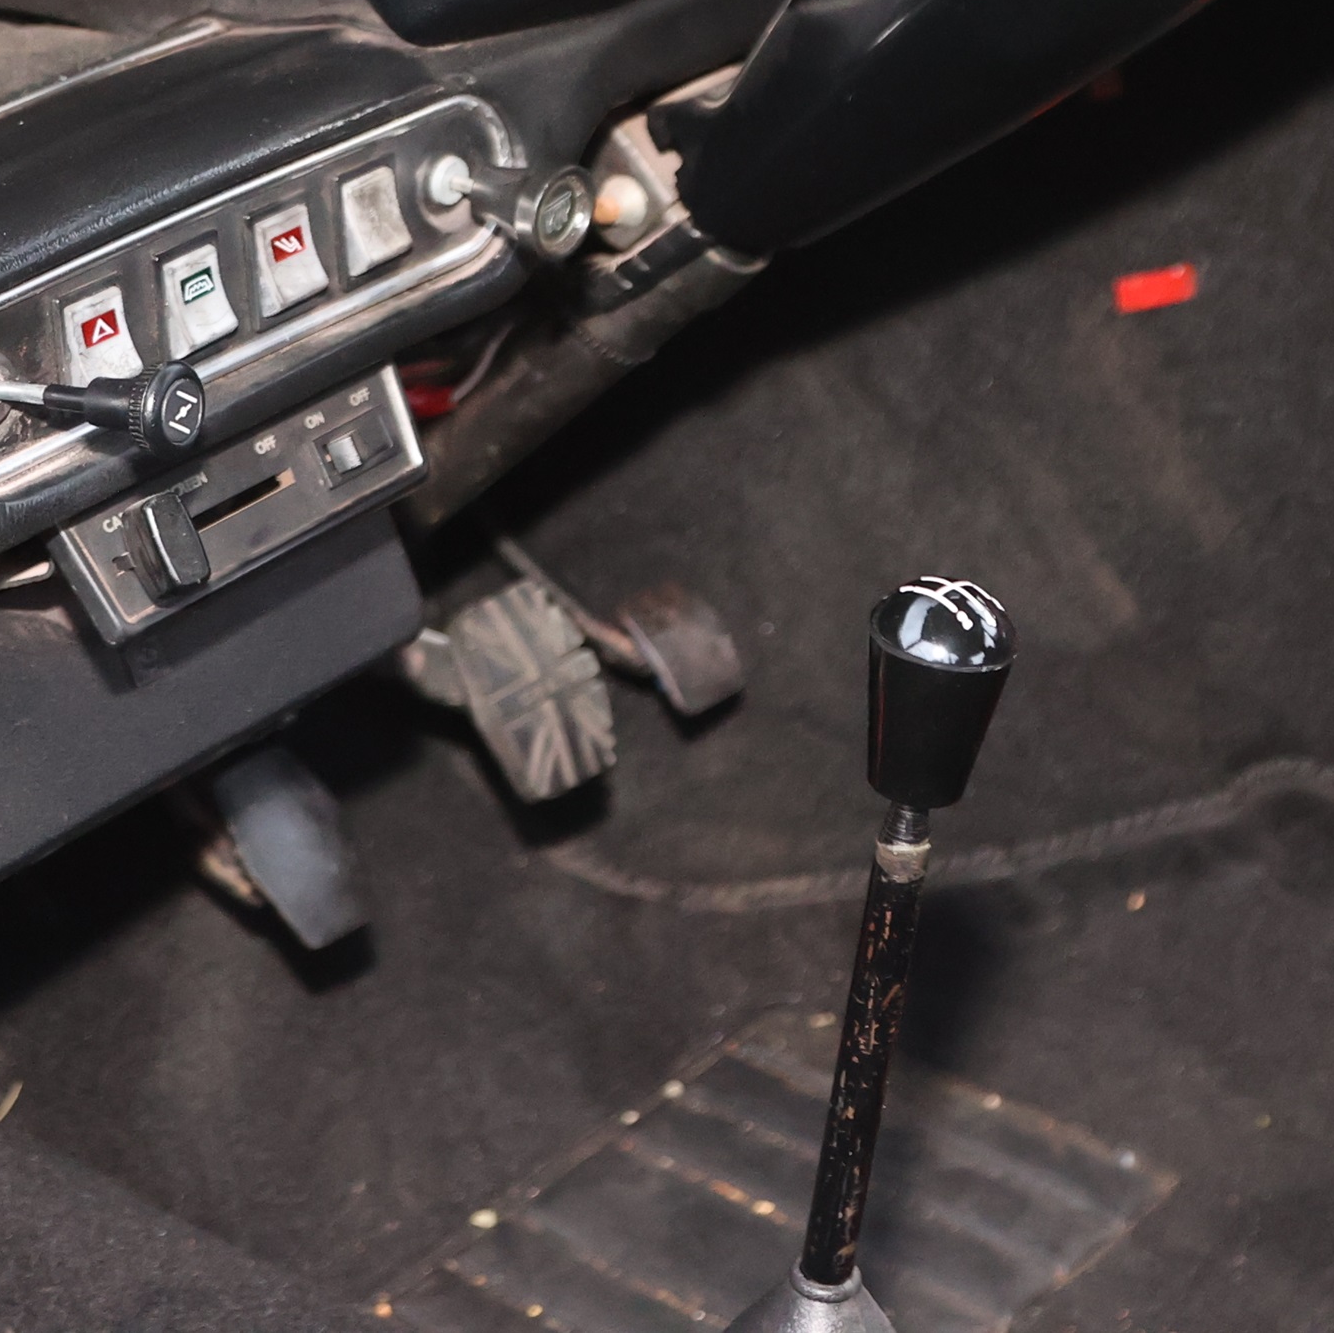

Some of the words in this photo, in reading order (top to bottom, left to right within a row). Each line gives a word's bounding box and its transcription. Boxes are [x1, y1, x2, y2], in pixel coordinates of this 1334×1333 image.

[349, 387, 370, 407] OFF
[304, 411, 325, 429] ON
[254, 434, 277, 455] OFF
[102, 512, 124, 533] CA
